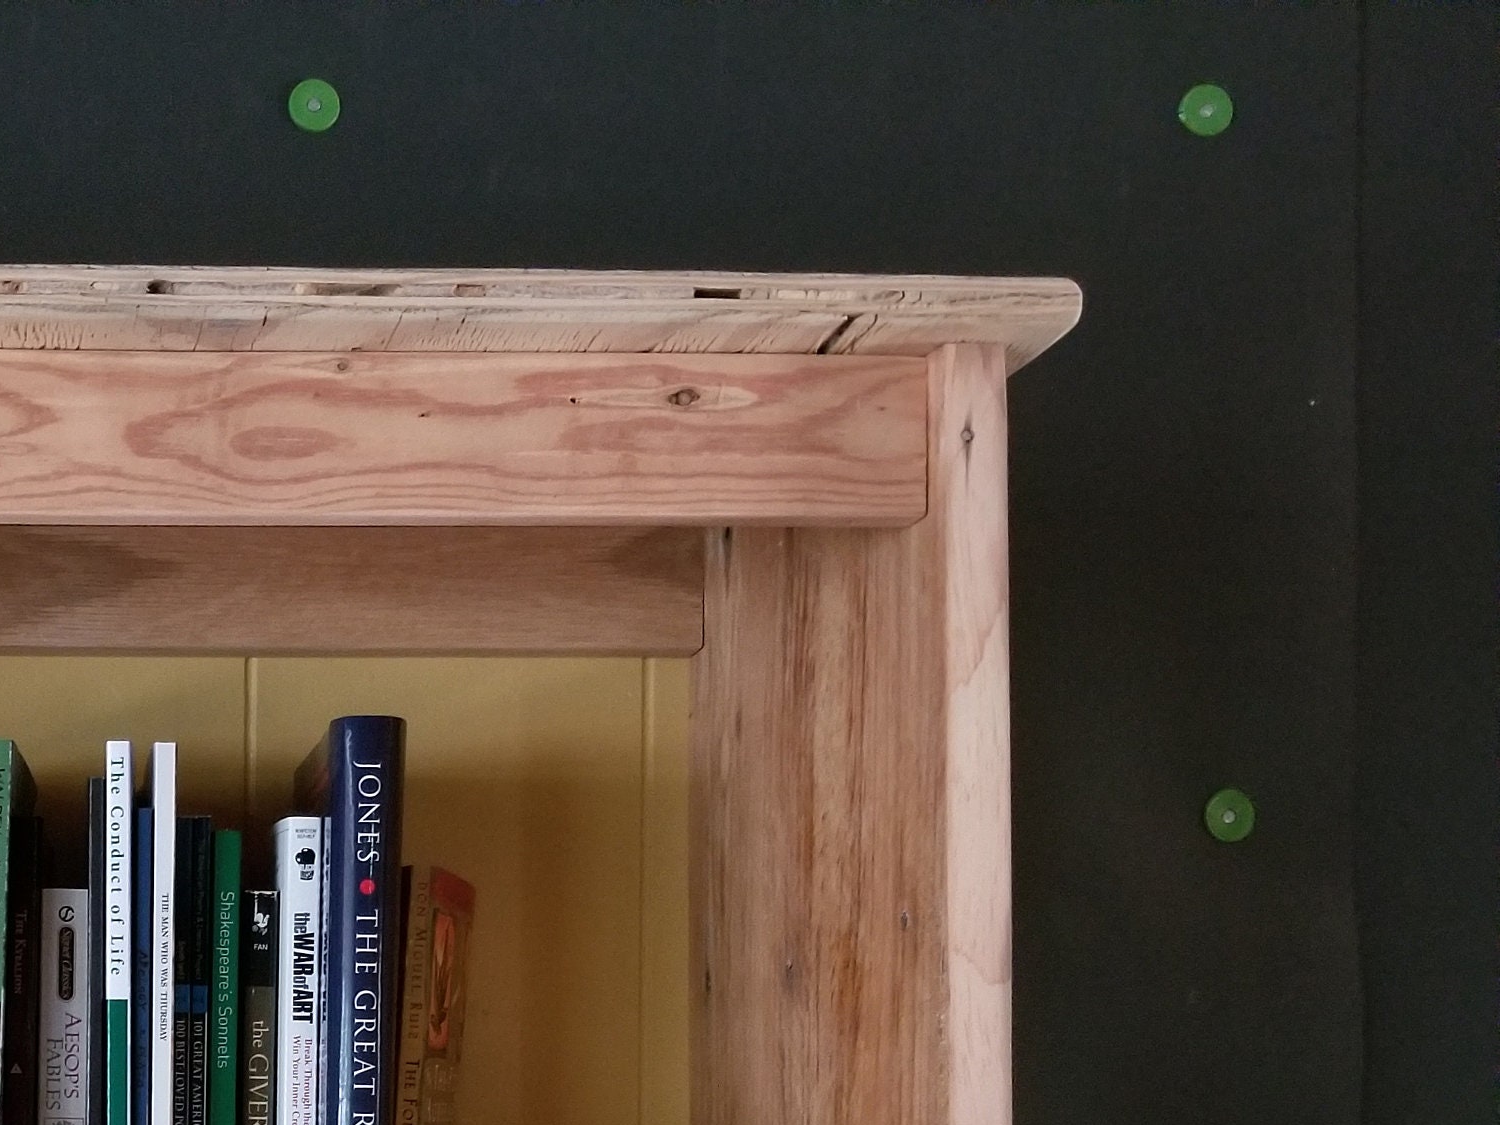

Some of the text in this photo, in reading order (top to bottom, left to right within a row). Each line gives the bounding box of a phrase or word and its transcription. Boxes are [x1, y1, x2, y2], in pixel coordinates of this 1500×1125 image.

[352, 761, 382, 864] JONES
[110, 756, 125, 976] The Conduct of Life
[354, 908, 380, 975] THE
[410, 927, 427, 992] MIGUEL
[159, 892, 170, 1042] THE MAN WHO WAS THURSDAY
[215, 891, 236, 1069] Shakespeare's Sonnets
[174, 1018, 186, 1038] 100
[192, 1020, 204, 1038] 101
[252, 1019, 267, 1048] the
[292, 1035, 302, 1055] Win
[352, 990, 379, 1096] GREAT
[64, 1011, 83, 1099] AESOP'S
[191, 1040, 203, 1081] GREAT
[292, 1058, 302, 1080] Your
[301, 1038, 313, 1066] Break
[45, 1037, 66, 1111] FABLES
[301, 1068, 313, 1110] Through
[404, 1059, 420, 1089] THE
[291, 1082, 301, 1109] Inner
